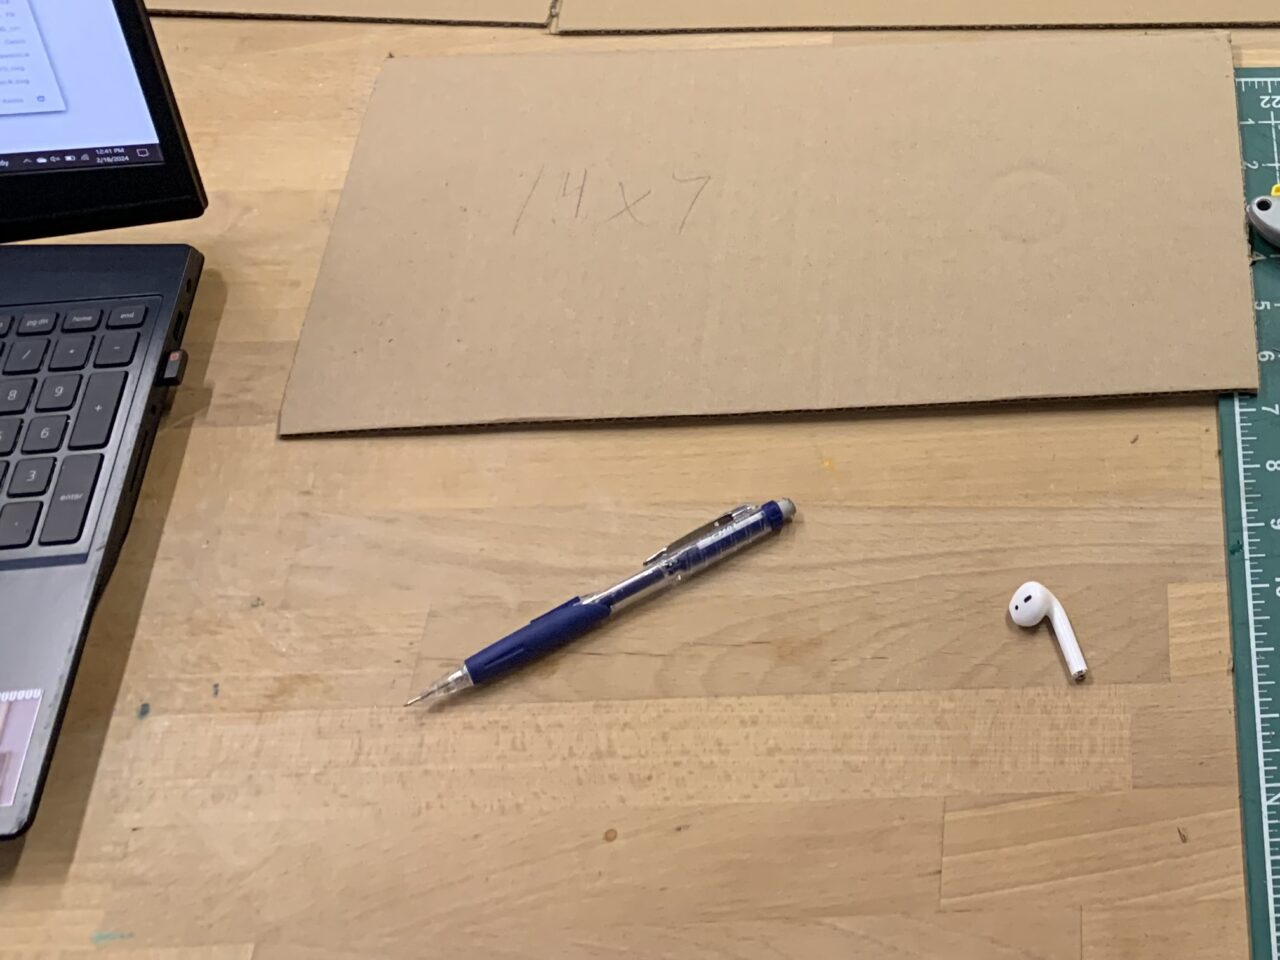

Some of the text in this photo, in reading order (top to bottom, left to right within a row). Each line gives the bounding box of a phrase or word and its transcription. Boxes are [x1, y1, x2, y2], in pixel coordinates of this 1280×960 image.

[1255, 301, 1271, 311] 5
[1258, 351, 1275, 362] 6
[8, 390, 17, 400] 8
[54, 386, 64, 397] 9
[1262, 404, 1280, 415] 7
[40, 427, 50, 439] 6
[27, 470, 36, 481] 3
